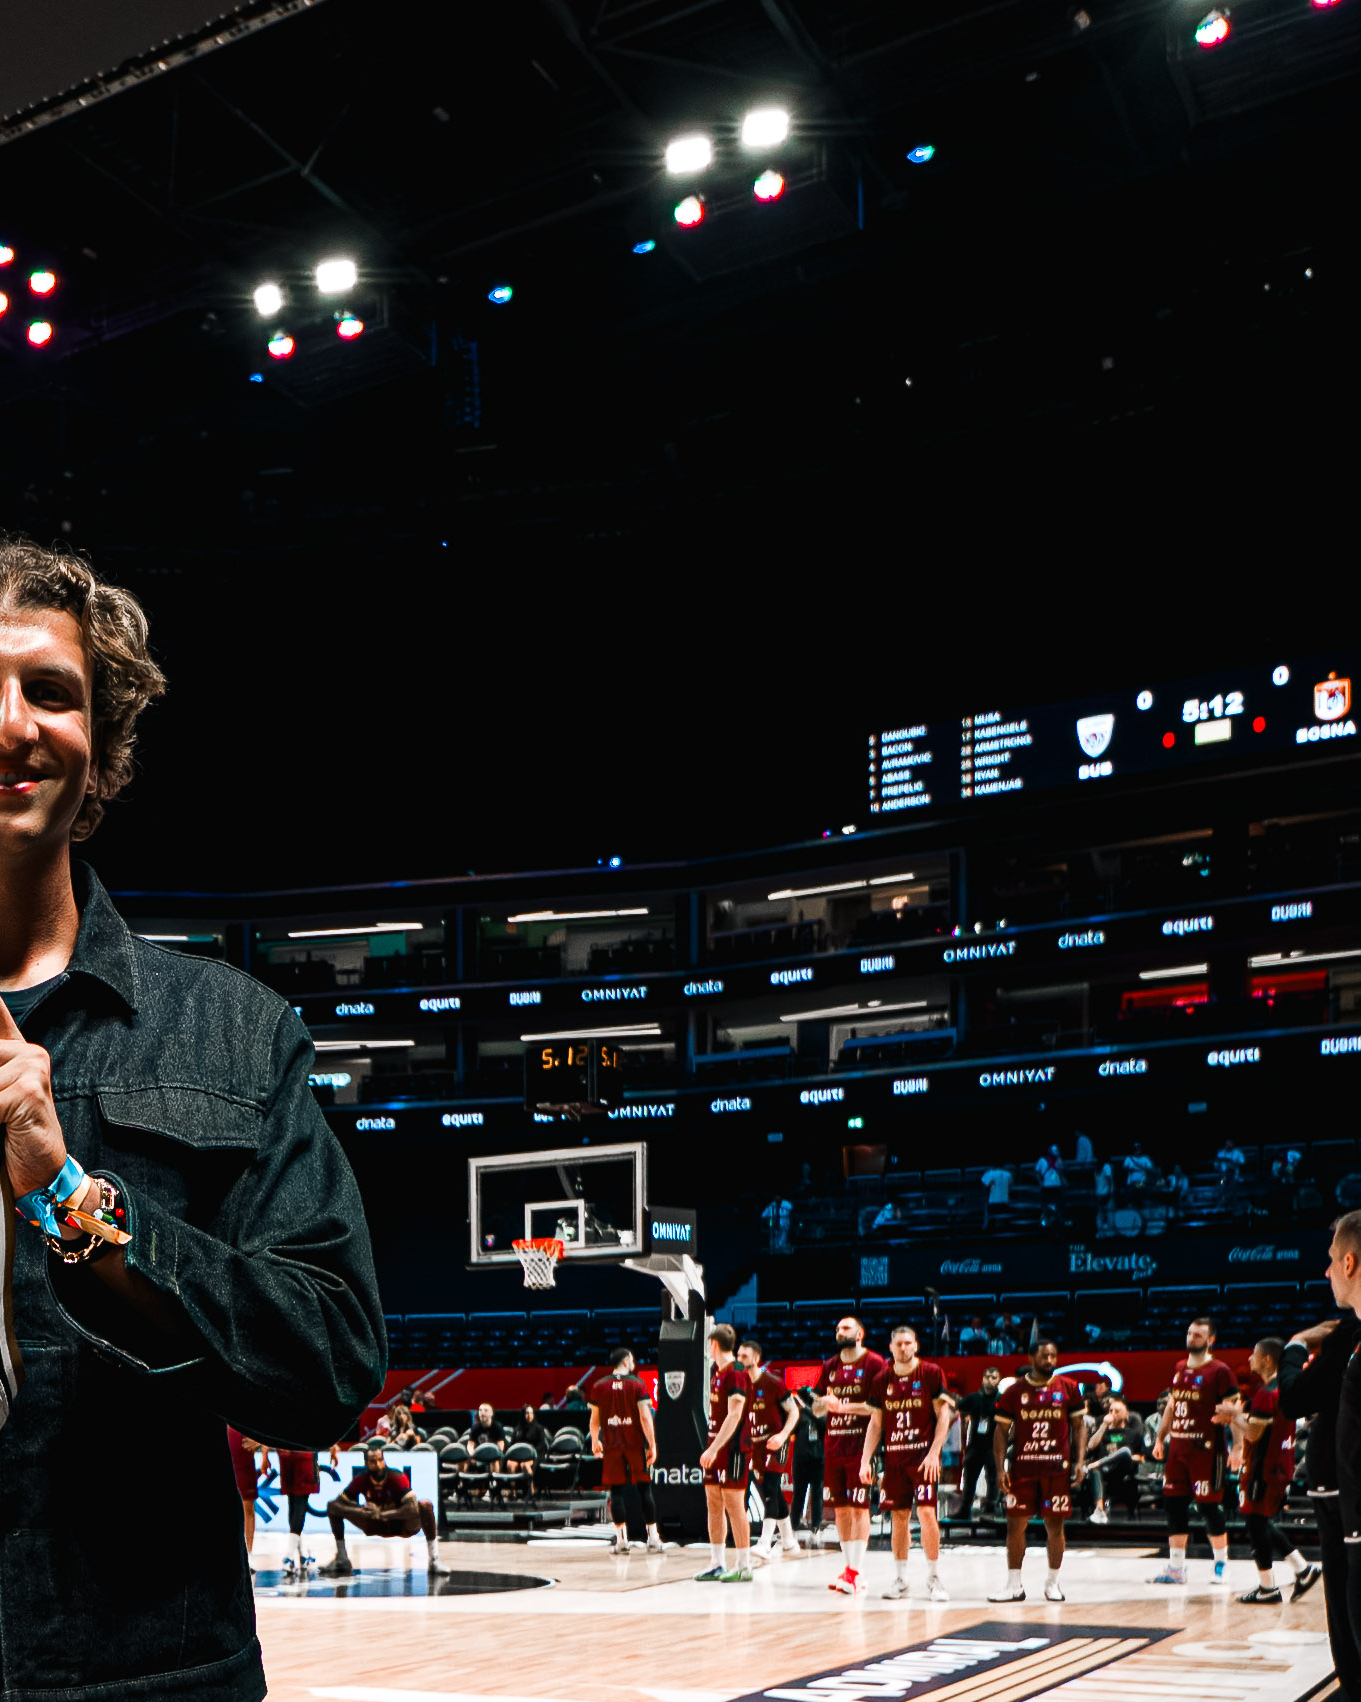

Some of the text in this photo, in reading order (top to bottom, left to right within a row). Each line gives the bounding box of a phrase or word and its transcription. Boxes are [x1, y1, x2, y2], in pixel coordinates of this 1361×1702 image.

[1272, 666, 1289, 687] 0
[1136, 690, 1153, 711] 0
[1182, 691, 1244, 722] 5:12
[1295, 720, 1356, 744] BOSNA
[1161, 916, 1213, 936] equiti
[1058, 930, 1105, 949] dnata
[943, 941, 1016, 962] OMNIYAT
[770, 968, 813, 986] equiti
[581, 987, 647, 1002] OMNIYAT
[683, 980, 723, 996] dnata
[335, 1002, 374, 1016] dnata
[419, 998, 460, 1013] equiti
[1098, 1058, 1147, 1076] dnata
[1206, 1048, 1260, 1068] equiti
[980, 1067, 1055, 1087] OMNIYAT
[710, 1097, 751, 1113] dnata
[800, 1088, 844, 1106] equiti
[441, 1113, 483, 1128] equiti
[608, 1104, 675, 1119] OMNIYAT
[356, 1117, 395, 1131] dnata
[652, 1221, 691, 1241] OMNIYAT
[896, 1411, 910, 1429] 21
[1032, 1421, 1049, 1438] 22
[650, 1464, 703, 1484] nata
[852, 1487, 866, 1503] 10
[917, 1484, 932, 1500] 21
[1052, 1495, 1069, 1512] 22
